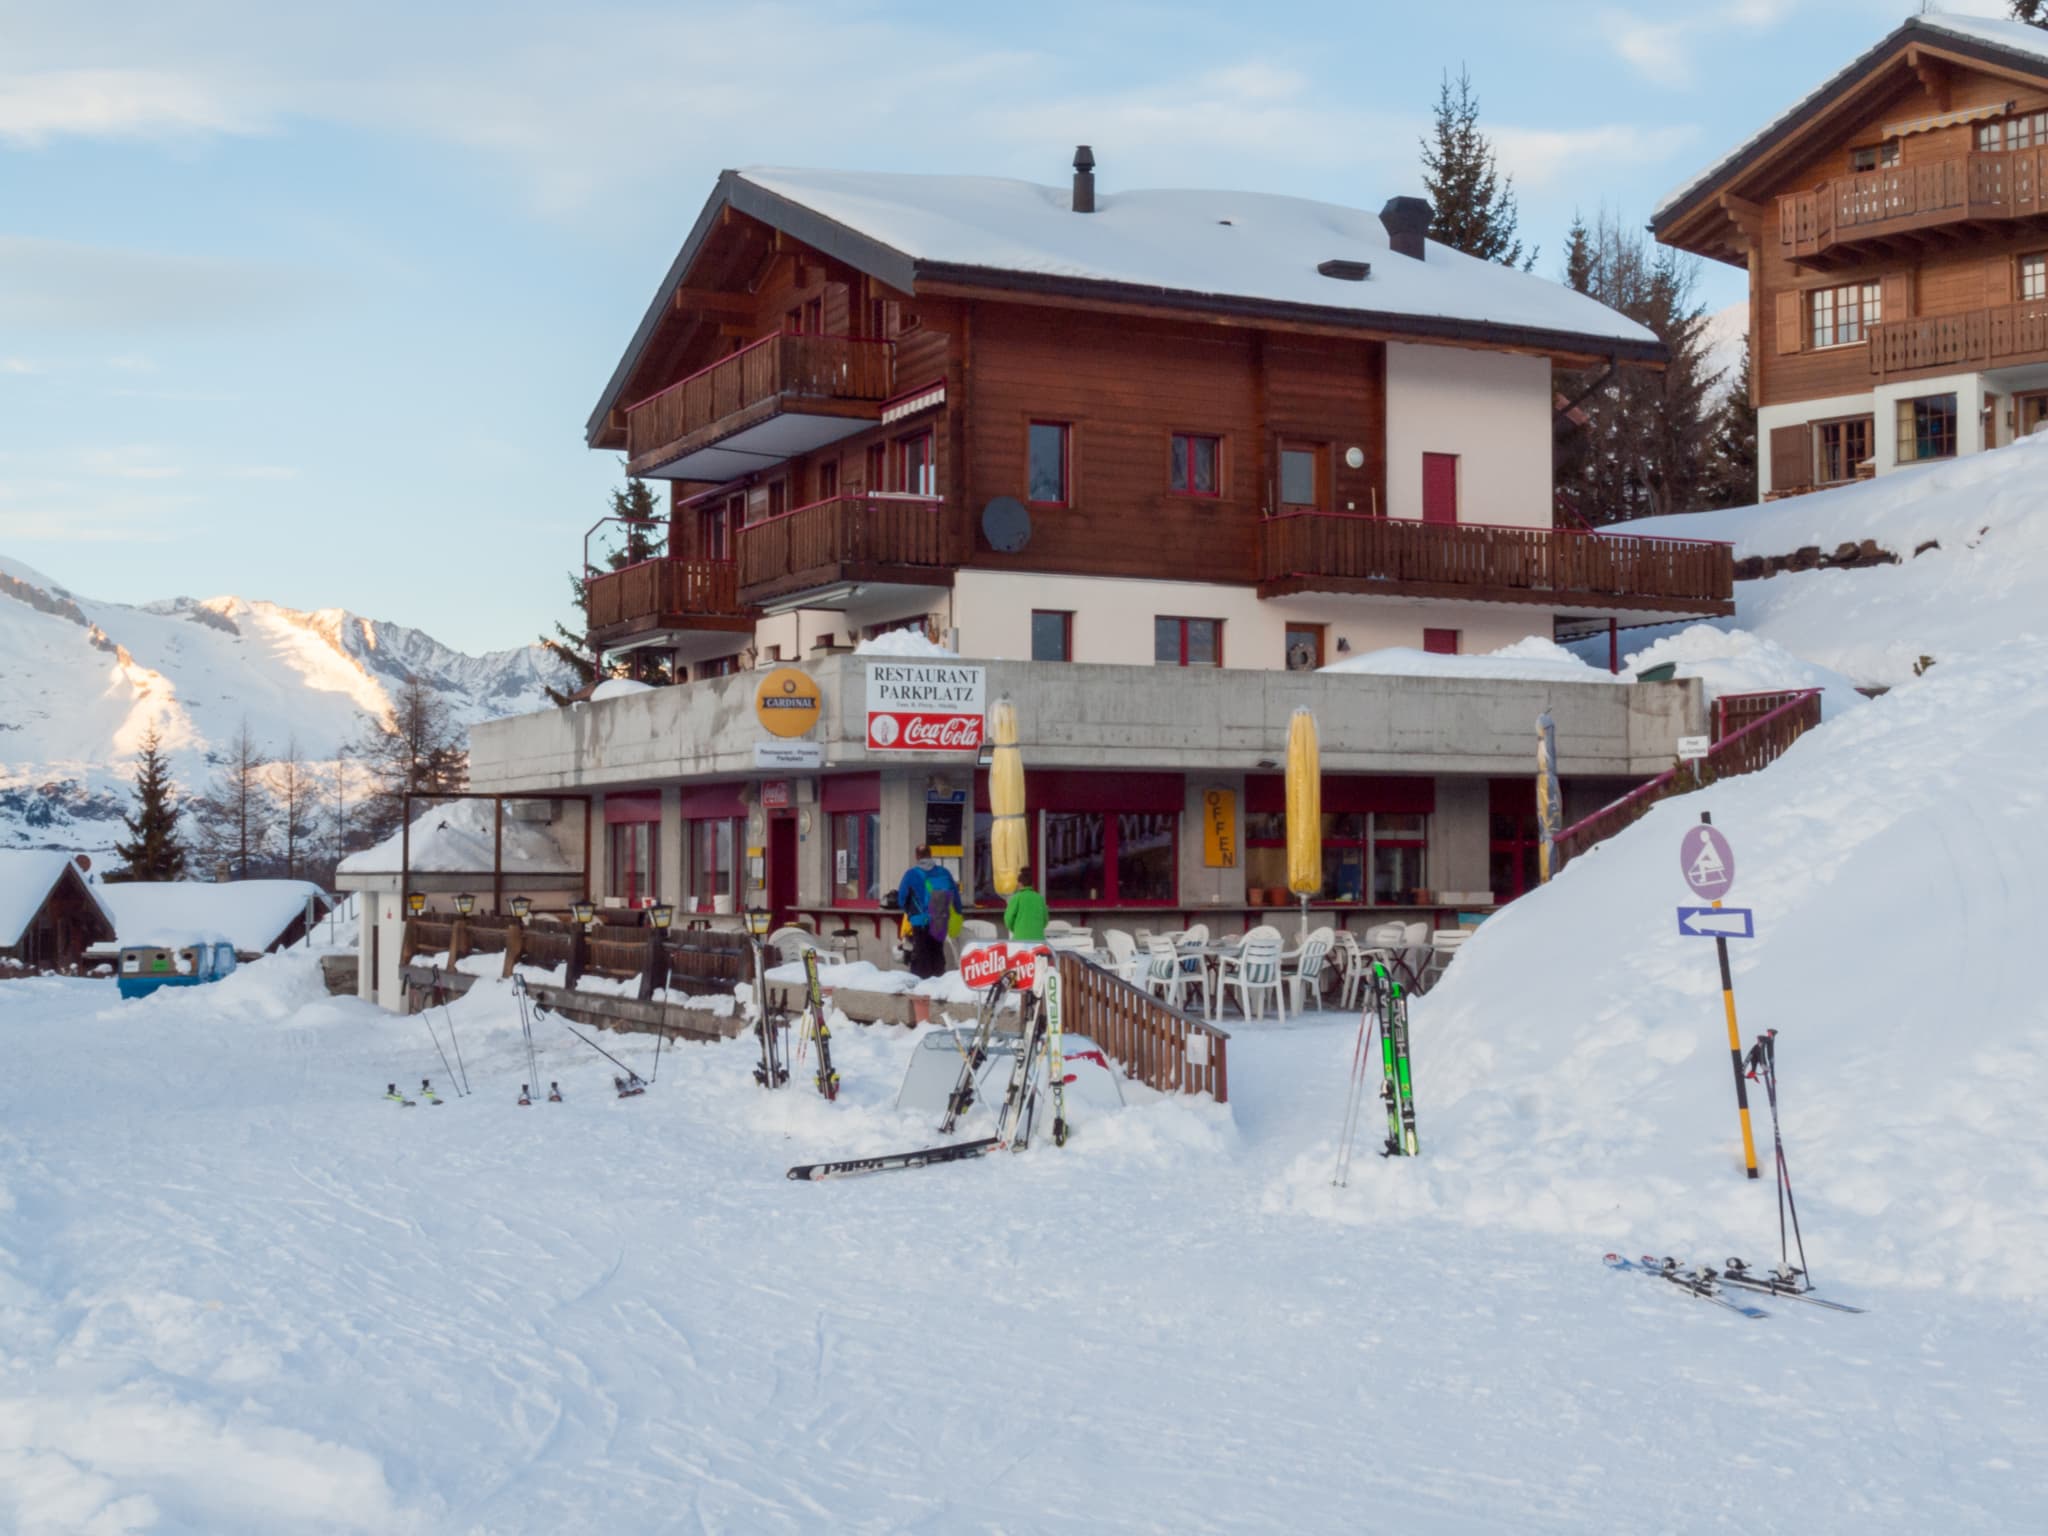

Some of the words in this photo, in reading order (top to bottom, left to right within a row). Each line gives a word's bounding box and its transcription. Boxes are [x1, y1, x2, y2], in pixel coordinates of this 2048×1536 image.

[875, 666, 978, 684] RESTAURANT
[766, 697, 812, 708] CARDINAL
[880, 685, 973, 701] PARKPLATZ
[904, 717, 979, 745] Coca-Cola
[1207, 791, 1233, 866] OFFEN
[965, 951, 1006, 980] rivella
[1049, 975, 1058, 1034] HEAD
